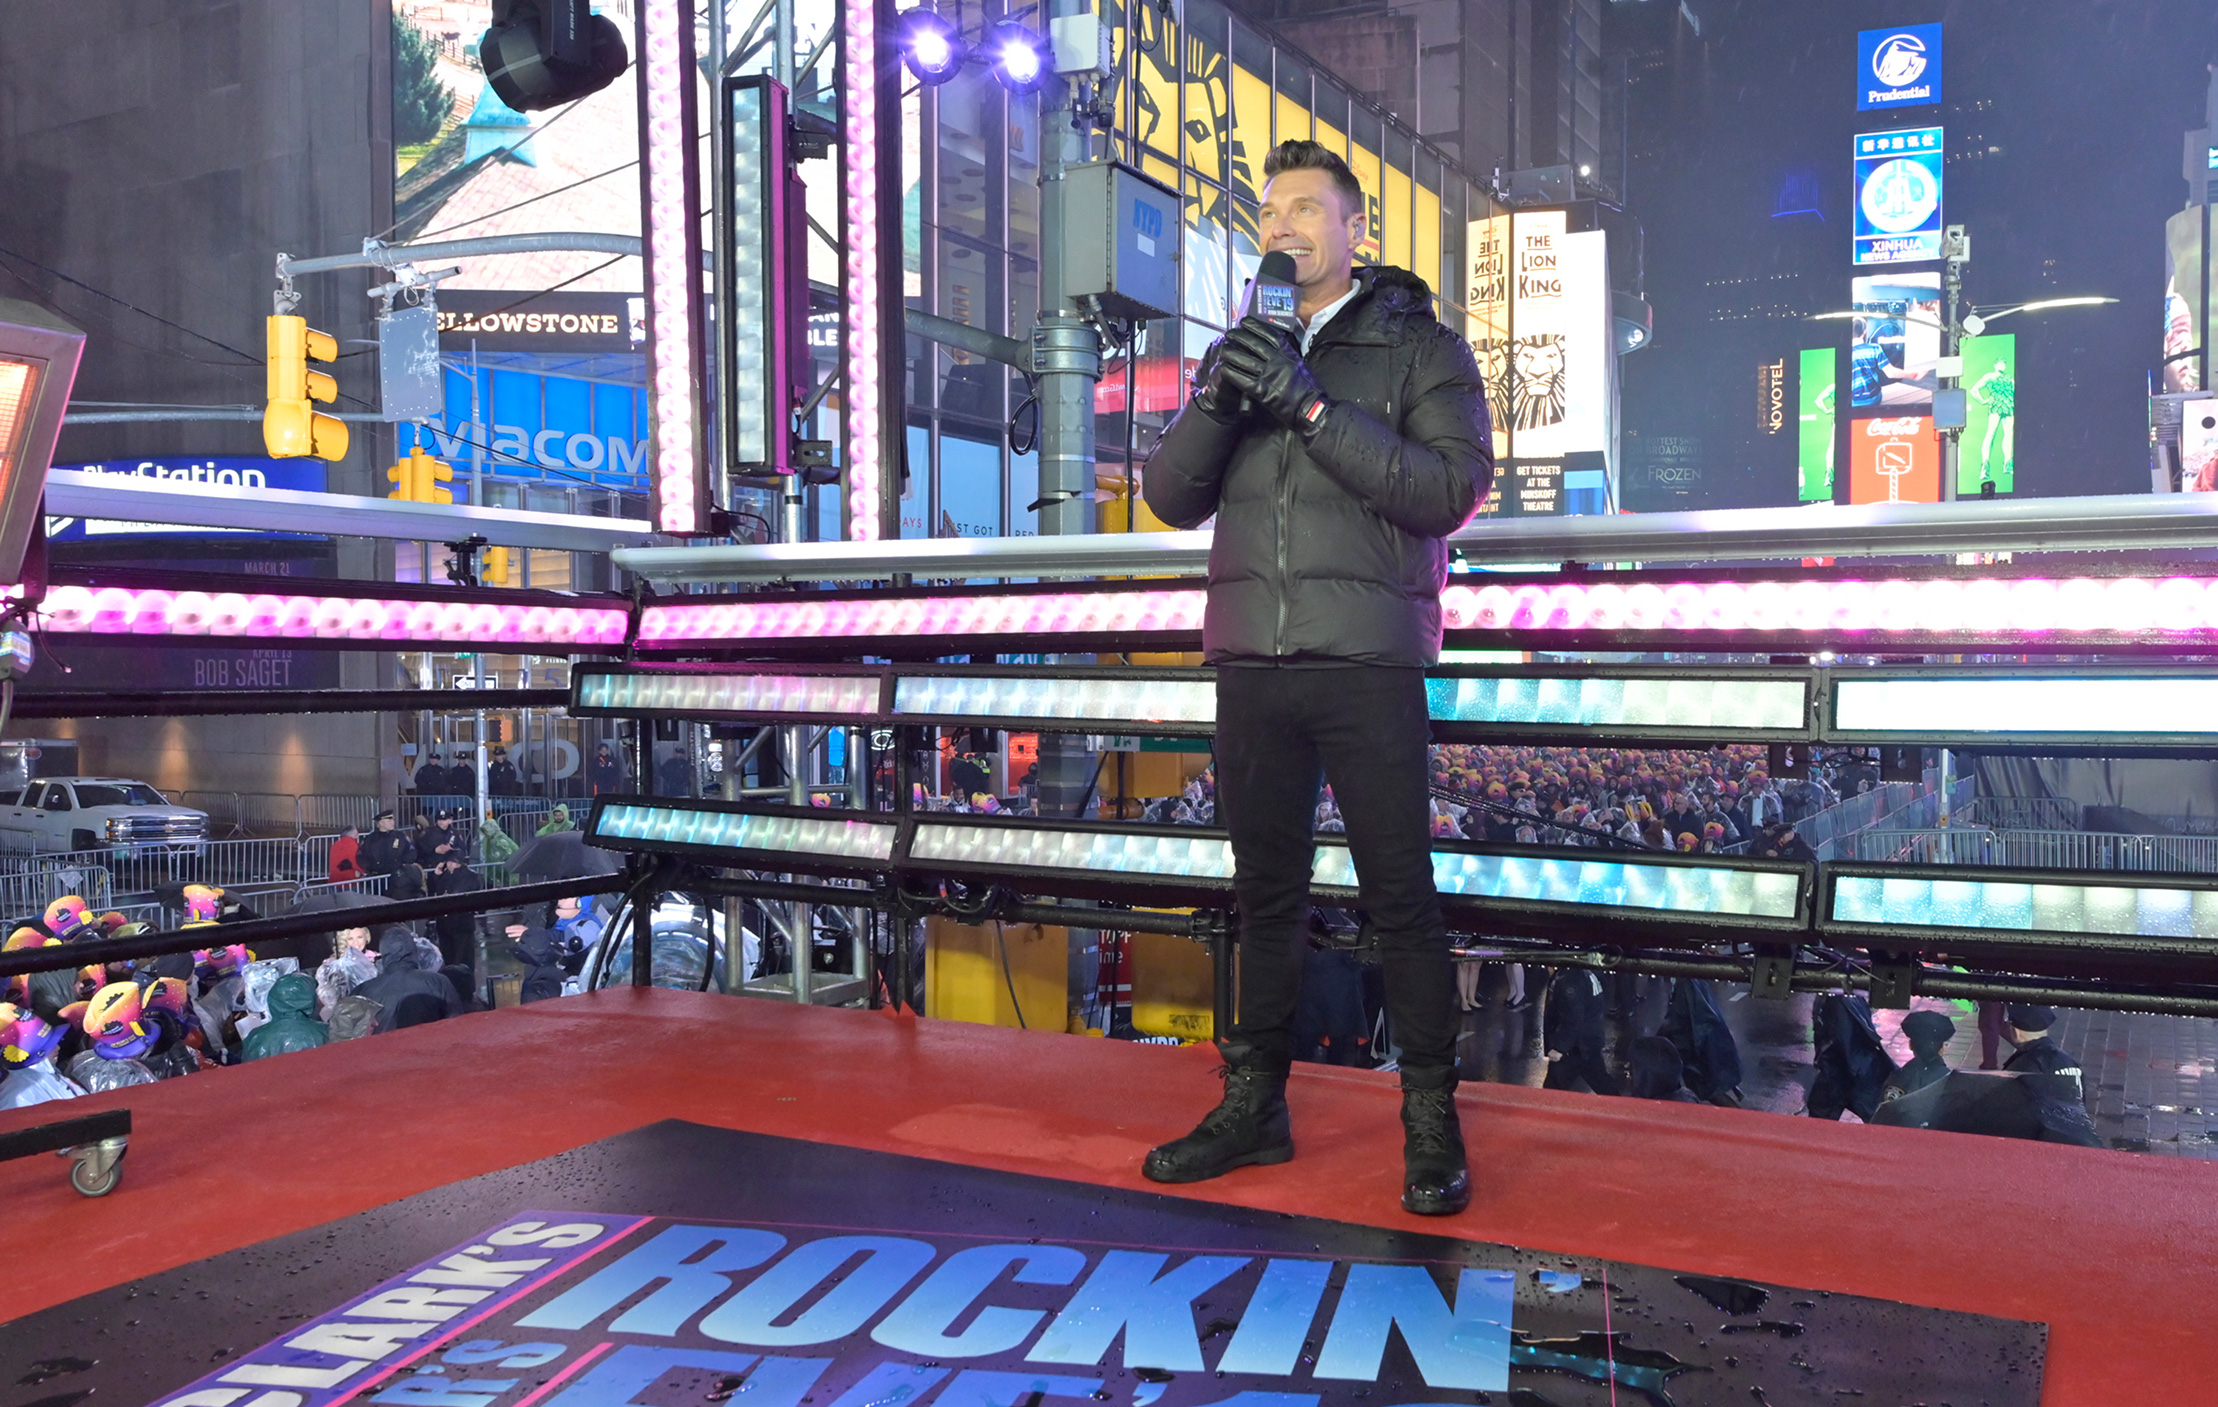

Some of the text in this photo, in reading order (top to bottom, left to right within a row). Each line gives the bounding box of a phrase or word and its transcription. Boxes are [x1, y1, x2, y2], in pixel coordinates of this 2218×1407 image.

[1868, 85, 1930, 103] Prudential
[1133, 197, 1162, 238] NYPD
[1526, 235, 1550, 247] THE
[1872, 238, 1924, 253] XINHUA
[1522, 252, 1556, 272] LION
[1519, 275, 1561, 299] KING
[437, 313, 618, 333] ELLOWSTONE
[1769, 358, 1783, 434] NOVOTEL
[1517, 466, 1561, 476] GET TICKETS
[1648, 465, 1702, 484] FROZEN
[1527, 478, 1550, 487] AT THE
[1520, 489, 1557, 500] MINSKOFF
[1523, 501, 1554, 511] THEATRE
[903, 517, 922, 528] AYS
[974, 525, 993, 536] GOT
[244, 562, 290, 576] MARCH 21
[195, 659, 292, 687] BOB SAGET
